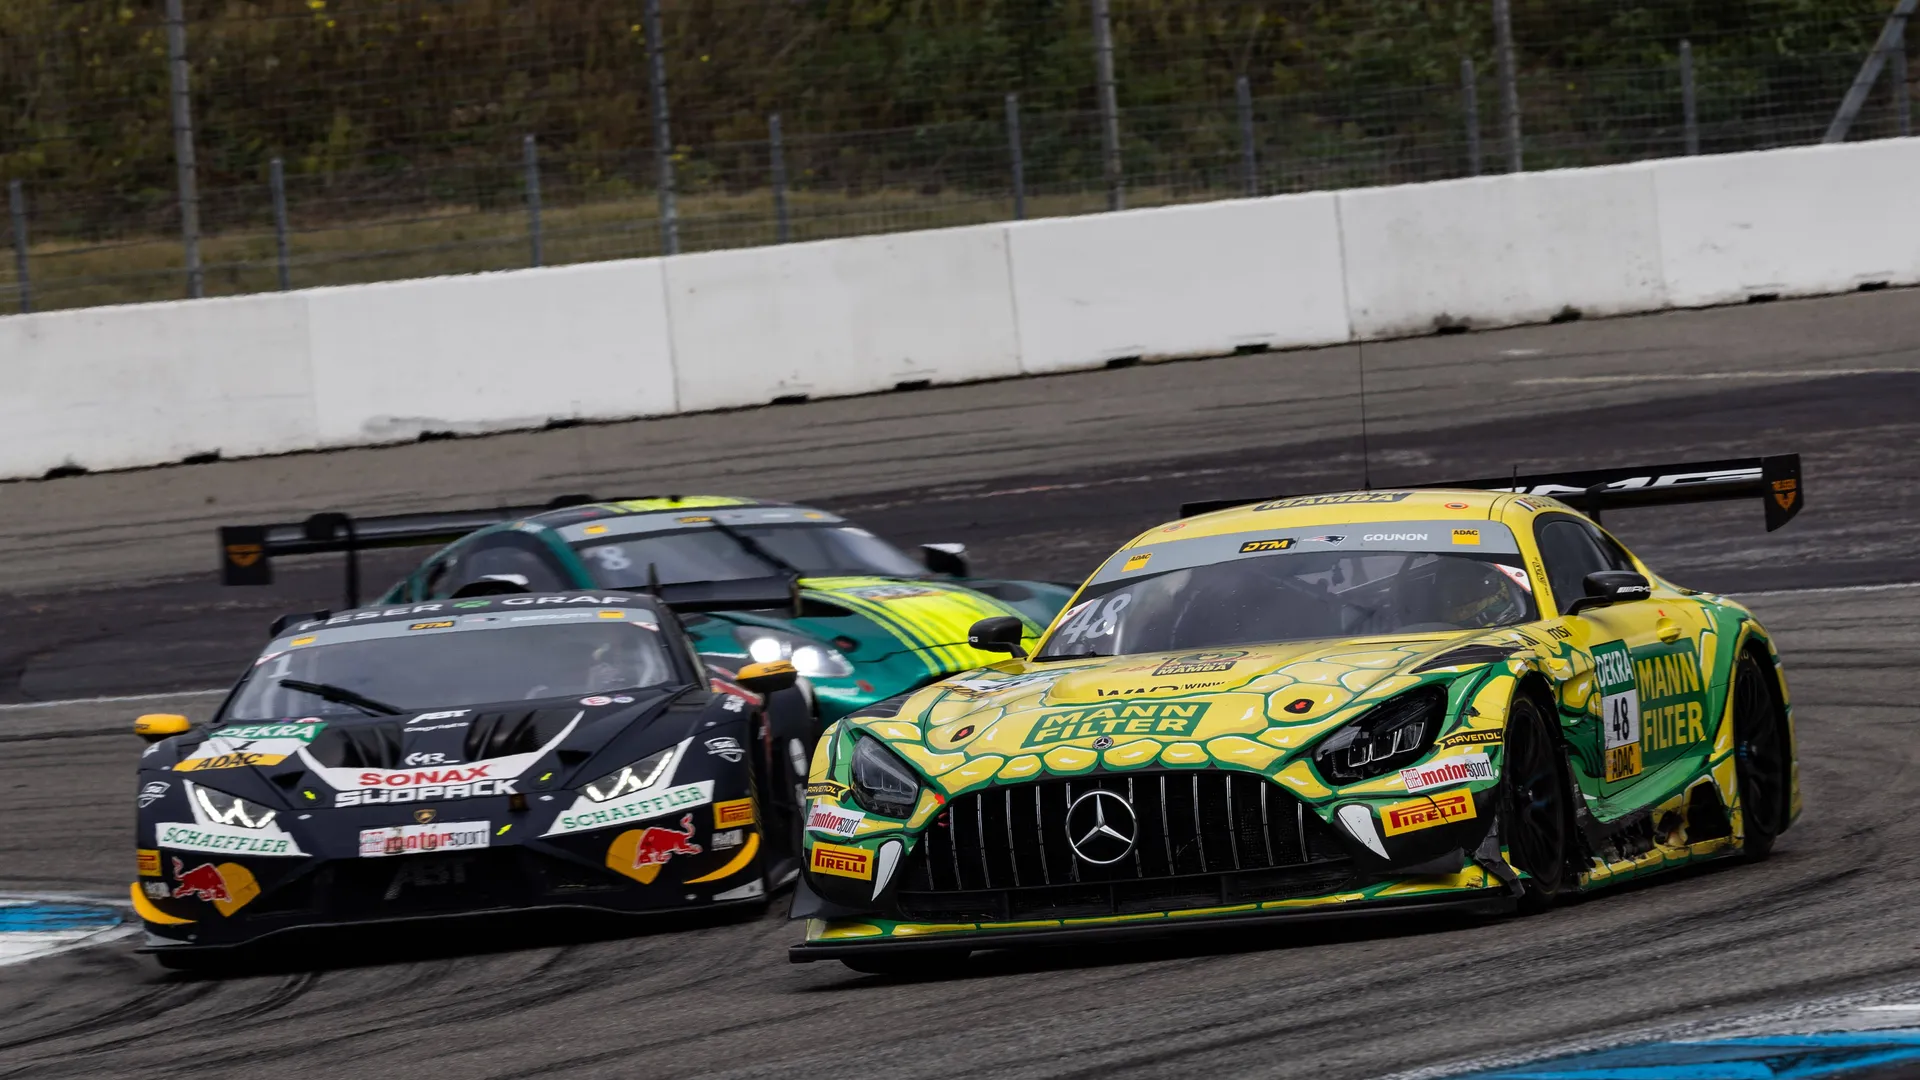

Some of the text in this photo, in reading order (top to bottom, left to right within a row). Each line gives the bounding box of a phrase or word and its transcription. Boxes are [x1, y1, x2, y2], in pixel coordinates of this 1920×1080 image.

[1262, 493, 1398, 510] MAMBA
[1363, 533, 1428, 542] GOUNON
[1453, 529, 1479, 537] ADAC
[1130, 553, 1152, 562] ADAC
[1242, 540, 1289, 552] DTM
[298, 596, 631, 631] FESER GRAF
[1062, 594, 1132, 645] 48
[267, 654, 293, 679] 1
[1157, 664, 1227, 676] MAMBA
[1595, 649, 1635, 688] DEKRA
[1636, 651, 1700, 702] MANN
[1042, 705, 1200, 728] MANN
[1612, 697, 1630, 741] 48
[1642, 701, 1707, 753] FILTER
[212, 724, 317, 738] DEKRA
[1033, 718, 1189, 743] FILTER
[1447, 731, 1501, 746] RAVENOL
[193, 753, 264, 770] ADAC
[1421, 762, 1492, 786] motorsport
[1612, 746, 1635, 780] ADAC
[359, 764, 494, 787] SONAX
[562, 786, 707, 831] SCHAEFFLER
[1389, 795, 1468, 830] PIRELLI
[812, 810, 861, 836] motorsport
[162, 827, 290, 853] SCHAEFFLER
[385, 829, 490, 856] motorsport
[814, 848, 868, 874] PIRELLI
